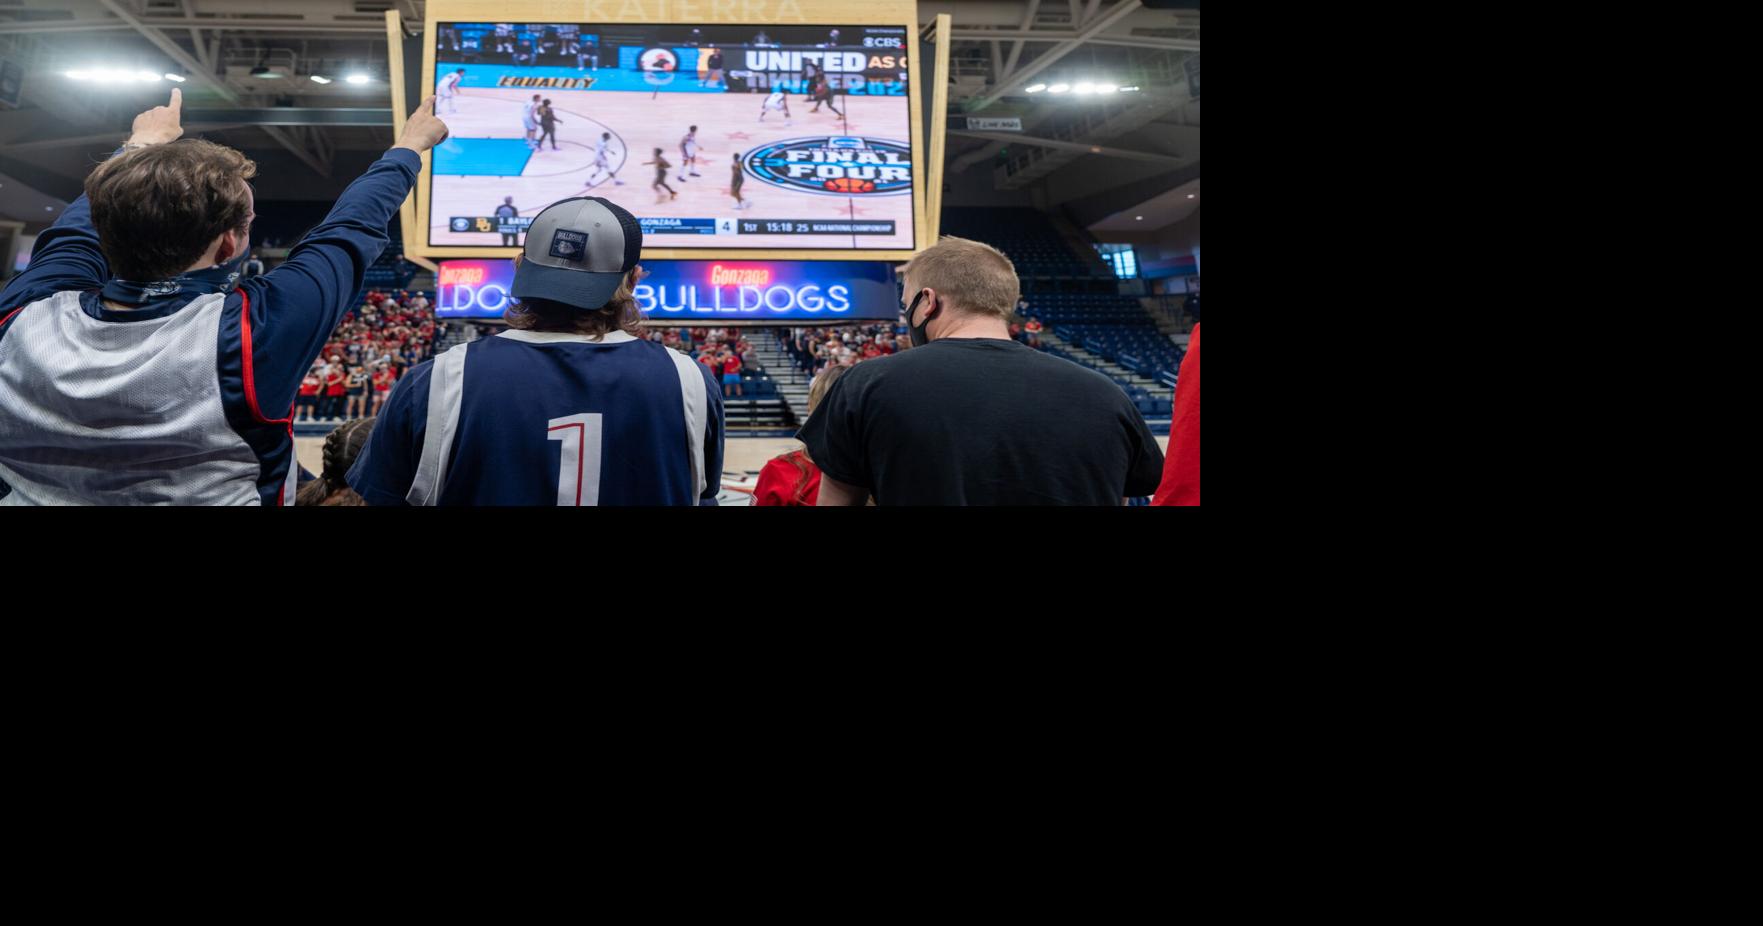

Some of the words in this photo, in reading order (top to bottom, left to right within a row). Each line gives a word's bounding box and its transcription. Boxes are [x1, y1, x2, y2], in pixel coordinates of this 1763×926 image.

[583, 0, 804, 21] KATERRA
[874, 37, 901, 48] CBS
[746, 51, 866, 72] UNITED
[868, 56, 895, 68] AS
[497, 75, 597, 89] EQUALITY
[786, 150, 910, 165] FINAL
[786, 164, 911, 181] FOUR
[508, 217, 534, 225] BAYLO
[640, 218, 682, 226] GONZAGA
[722, 221, 730, 232] 4
[766, 222, 793, 232] 15:18
[796, 223, 808, 233] 25
[711, 264, 769, 287] Gonzaga
[435, 284, 516, 311] LDO
[632, 284, 850, 312] BULLDOGS
[547, 412, 603, 507] 1
